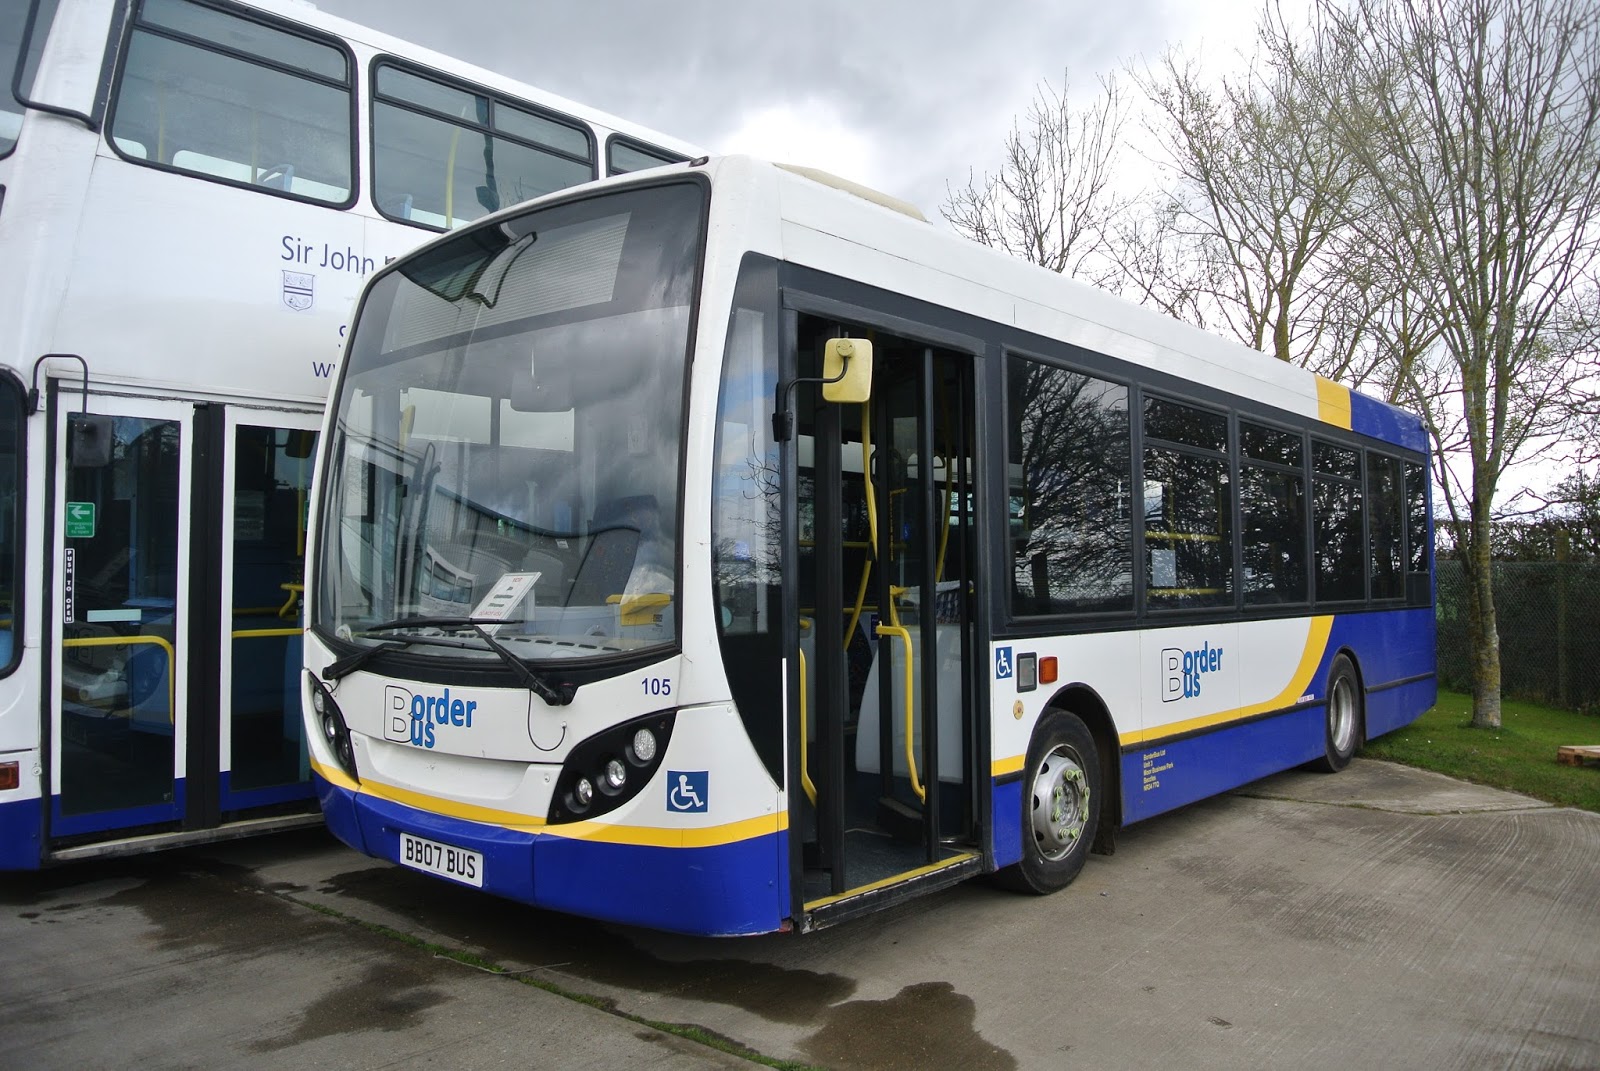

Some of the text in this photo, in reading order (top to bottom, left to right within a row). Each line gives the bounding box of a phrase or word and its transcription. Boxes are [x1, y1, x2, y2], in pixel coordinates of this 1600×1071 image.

[281, 235, 374, 275] Sir John
[66, 580, 72, 592] TO
[641, 677, 672, 696] 105
[1161, 641, 1223, 702] Border
[383, 685, 477, 742] Border
[405, 838, 476, 878] BB07 BUS
